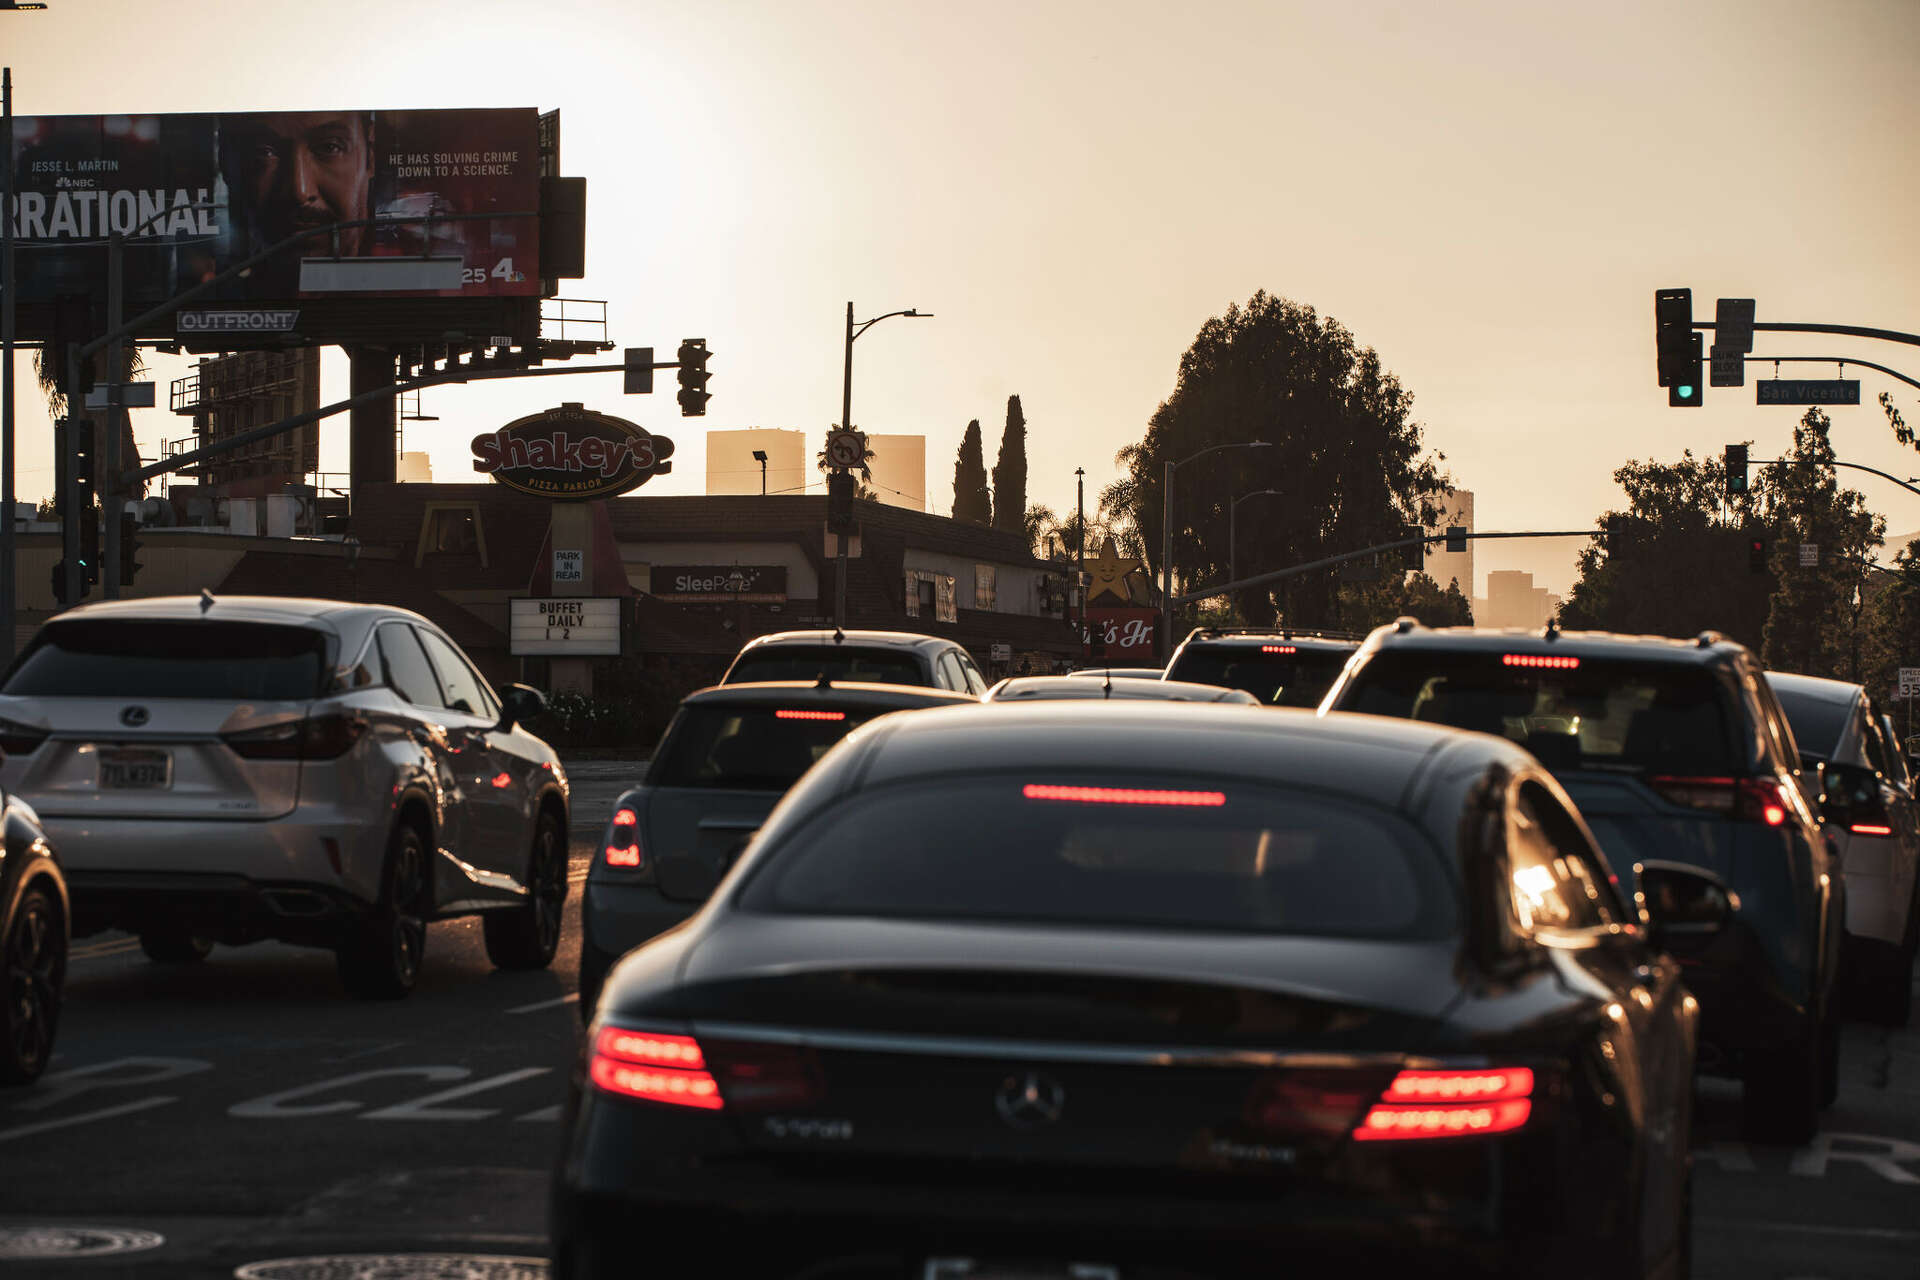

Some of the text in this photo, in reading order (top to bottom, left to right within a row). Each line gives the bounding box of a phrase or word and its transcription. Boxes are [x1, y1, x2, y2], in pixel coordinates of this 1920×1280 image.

[389, 151, 518, 165] HE HAS SOLVING CRIME
[32, 160, 119, 172] JESSE L. MARTIN
[398, 164, 512, 178] DOWN TO A SCIENCE.
[73, 179, 95, 187] NBC
[491, 257, 513, 282] 4
[462, 268, 487, 284] 25
[181, 311, 293, 330] OUTFRONT
[1762, 384, 1856, 399] San Vicente
[528, 478, 603, 491] PIZZA PARLOR
[556, 551, 580, 561] PARK
[563, 562, 573, 570] IN
[556, 571, 580, 580] REAR
[540, 602, 583, 614] BUFFET
[548, 615, 584, 627] DAILY
[563, 628, 570, 640] 2
[1120, 619, 1154, 648] Jr.
[1902, 684, 1920, 696] 35
